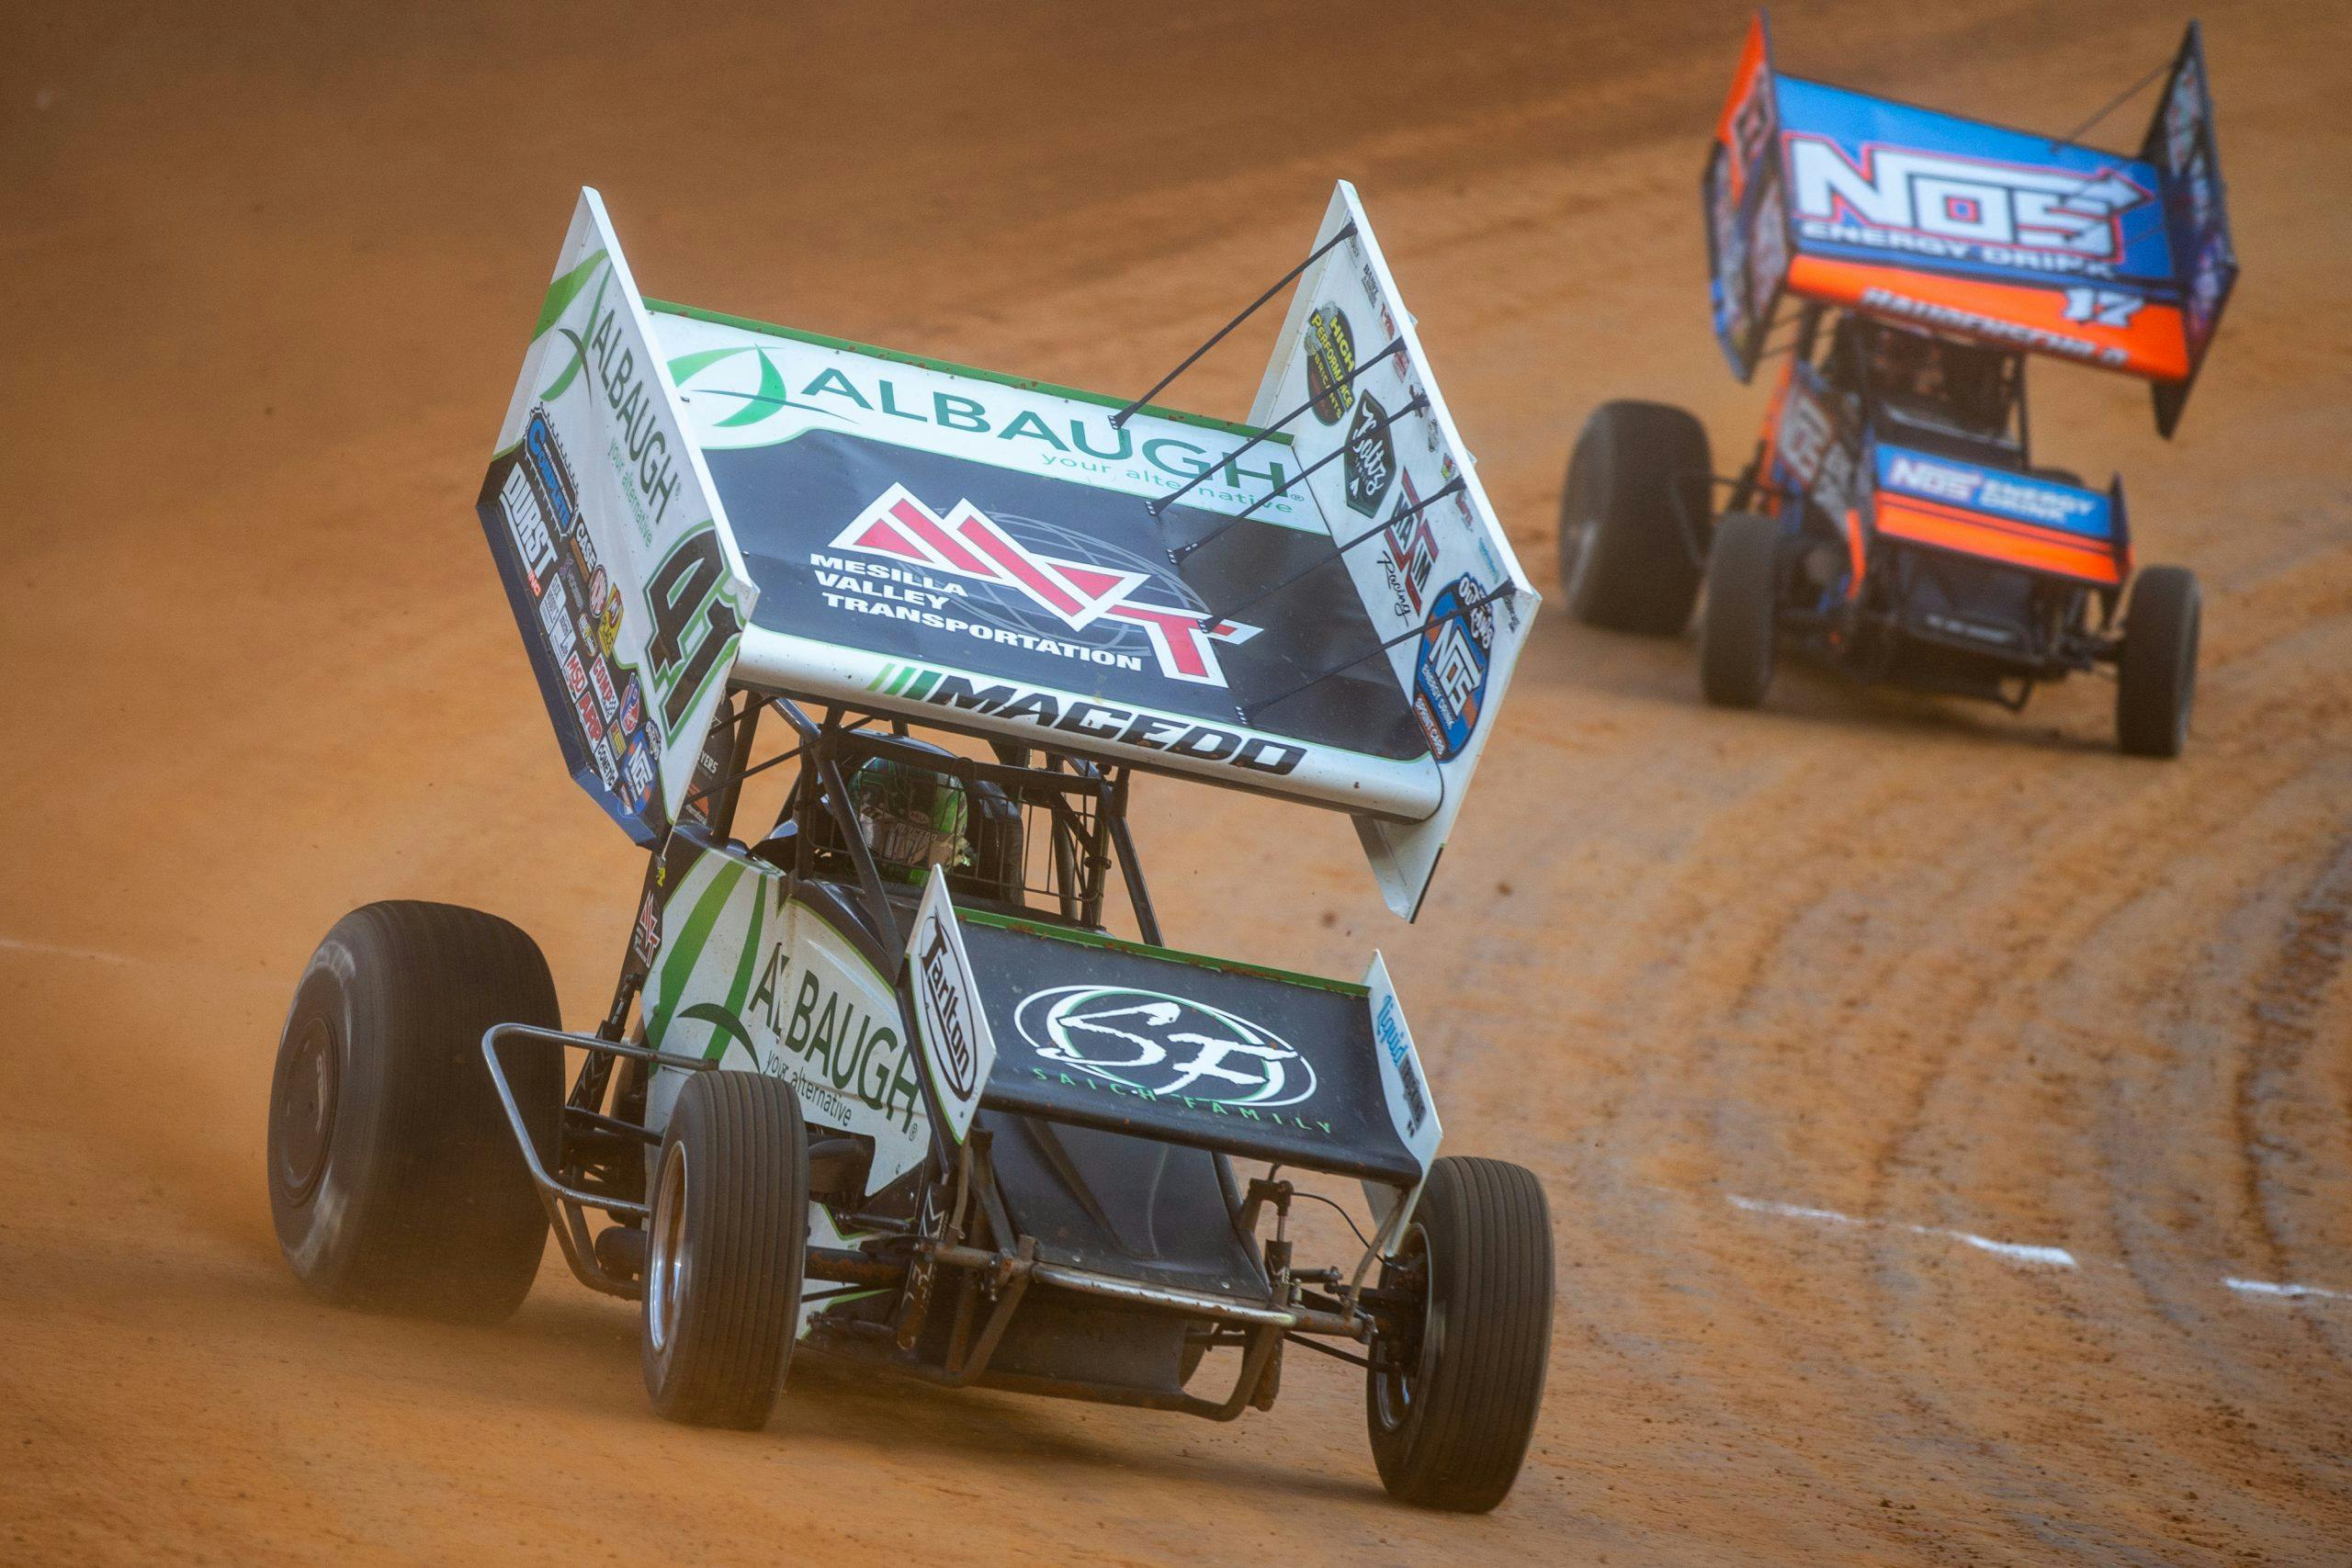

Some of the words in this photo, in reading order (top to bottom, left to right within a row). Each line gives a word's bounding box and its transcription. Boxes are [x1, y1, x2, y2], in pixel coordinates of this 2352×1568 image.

[1785, 134, 2150, 258] NOS
[1330, 316, 1354, 372] HIGH
[801, 367, 1288, 497] ALBAUGH
[1042, 454, 1110, 473] your
[1126, 468, 1293, 513] altenative
[503, 461, 558, 579] DURST
[576, 523, 596, 572] CASE
[810, 553, 967, 597] MESILLA
[814, 571, 950, 610] VALLEY
[1377, 550, 1410, 626] Racing
[821, 592, 1142, 671] TRANSPORTATION
[567, 654, 583, 694] MSD
[594, 657, 613, 703] COMP
[1429, 617, 1483, 717] NOS
[578, 694, 602, 742] ARP
[918, 676, 1307, 776] MACEDO
[921, 906, 969, 1079] Tarlton
[791, 1066, 853, 1127] alternative
